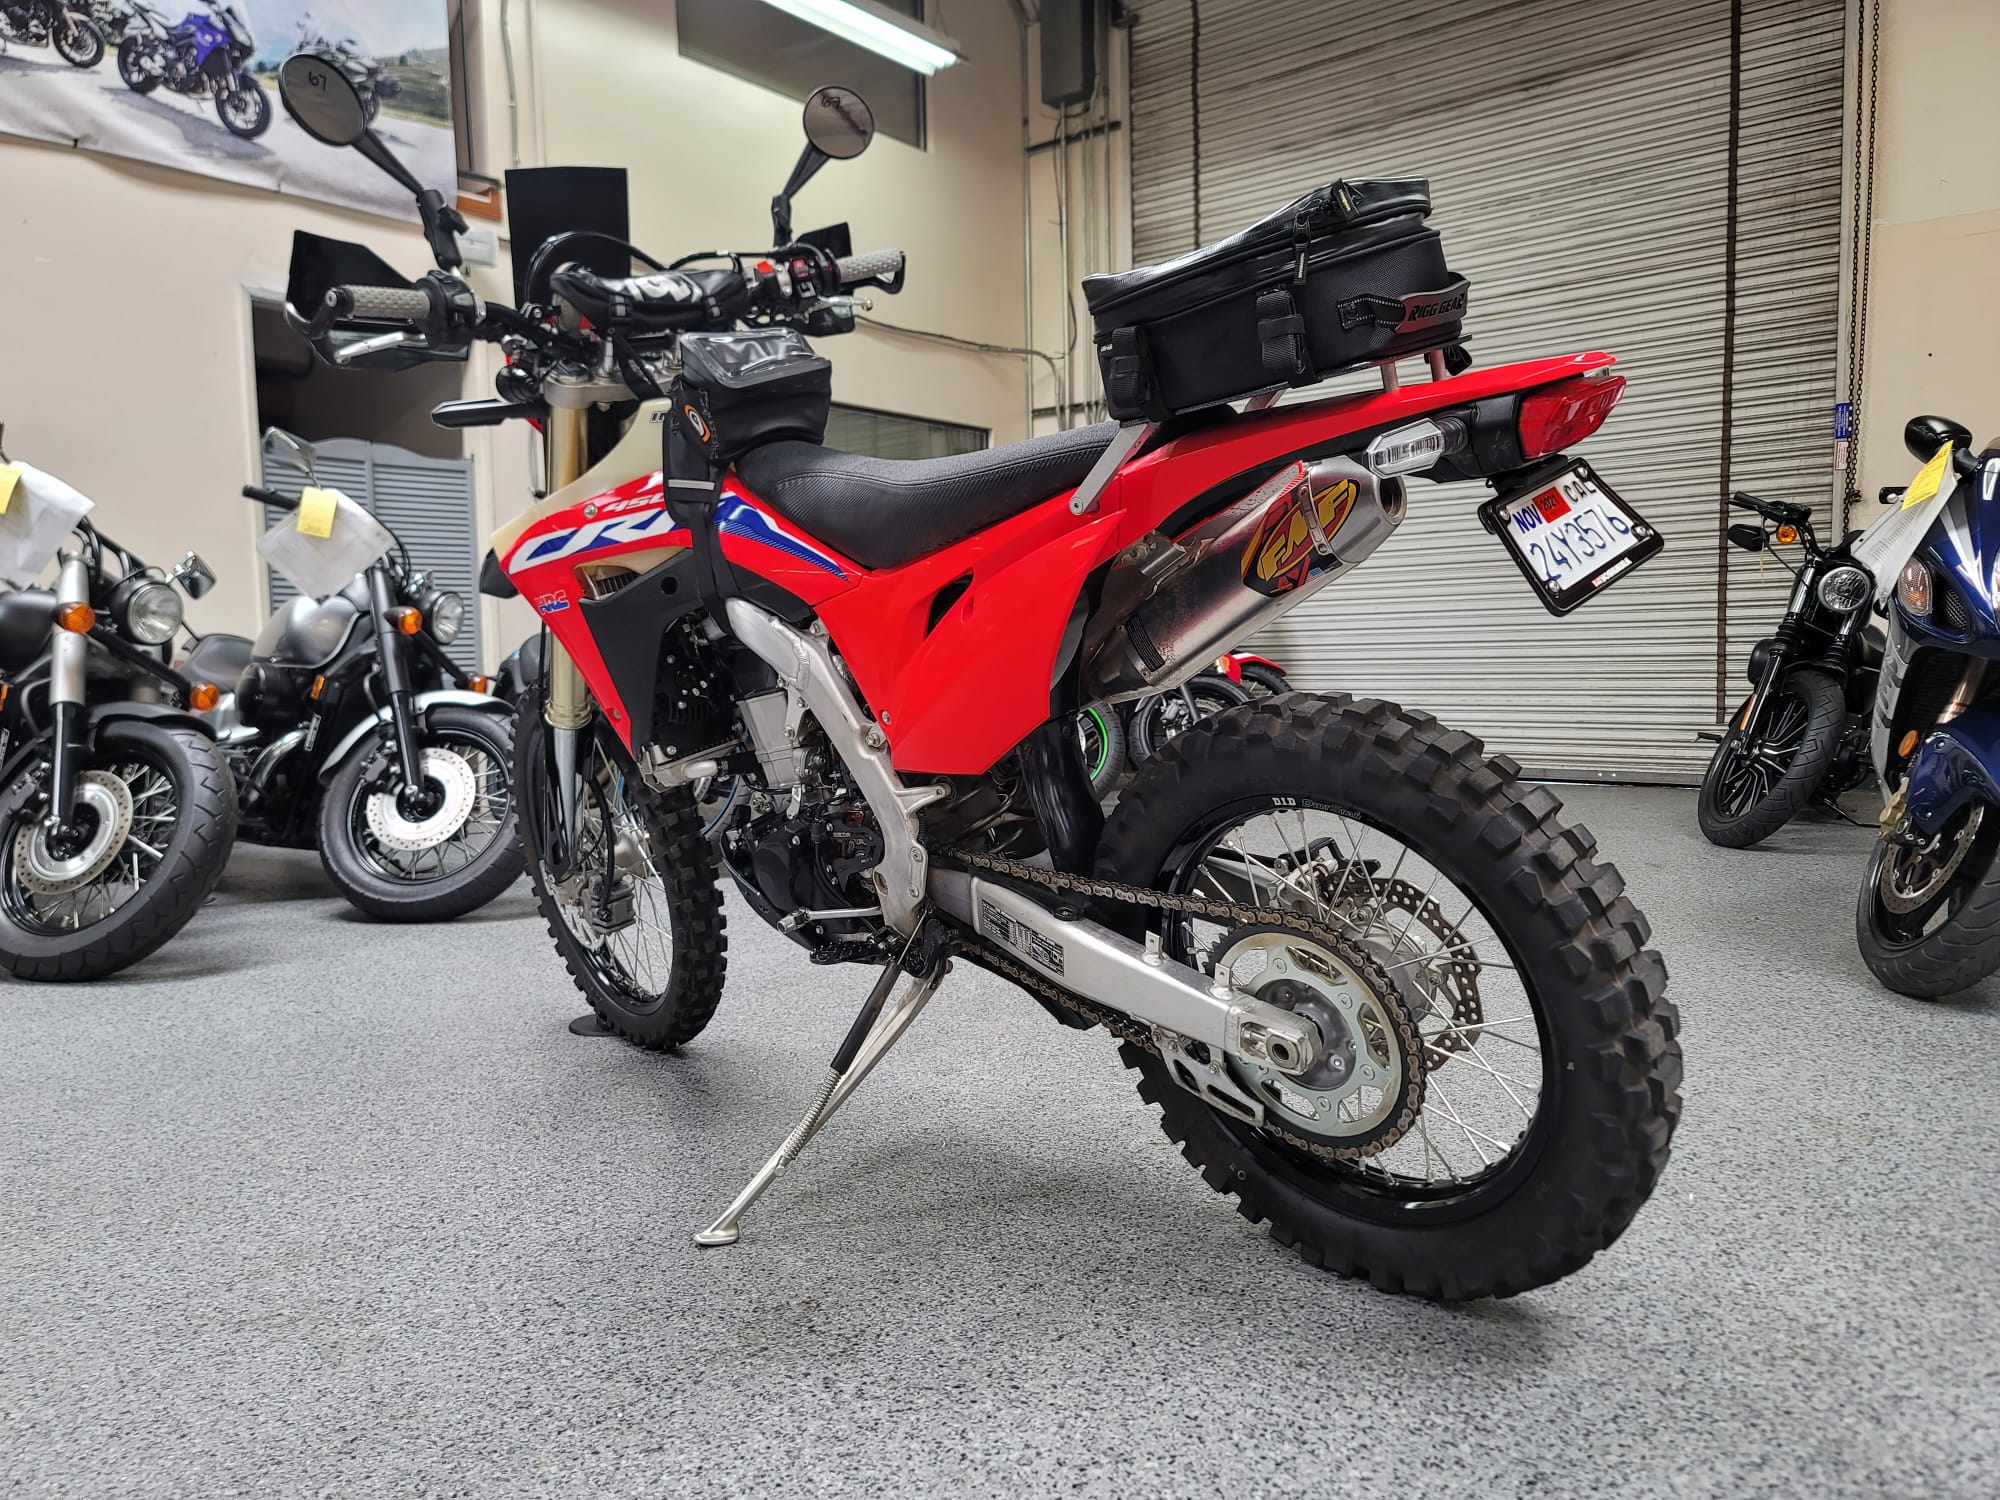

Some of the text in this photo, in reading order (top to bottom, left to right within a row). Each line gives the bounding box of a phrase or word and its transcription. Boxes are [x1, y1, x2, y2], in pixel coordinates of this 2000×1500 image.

[308, 71, 328, 92] 67
[1408, 292, 1466, 322] RIGG GEAR
[1261, 479, 1350, 582] FMF
[1512, 503, 1543, 535] NOV
[1529, 504, 1630, 581] 24Y3576
[534, 589, 570, 615] HRC
